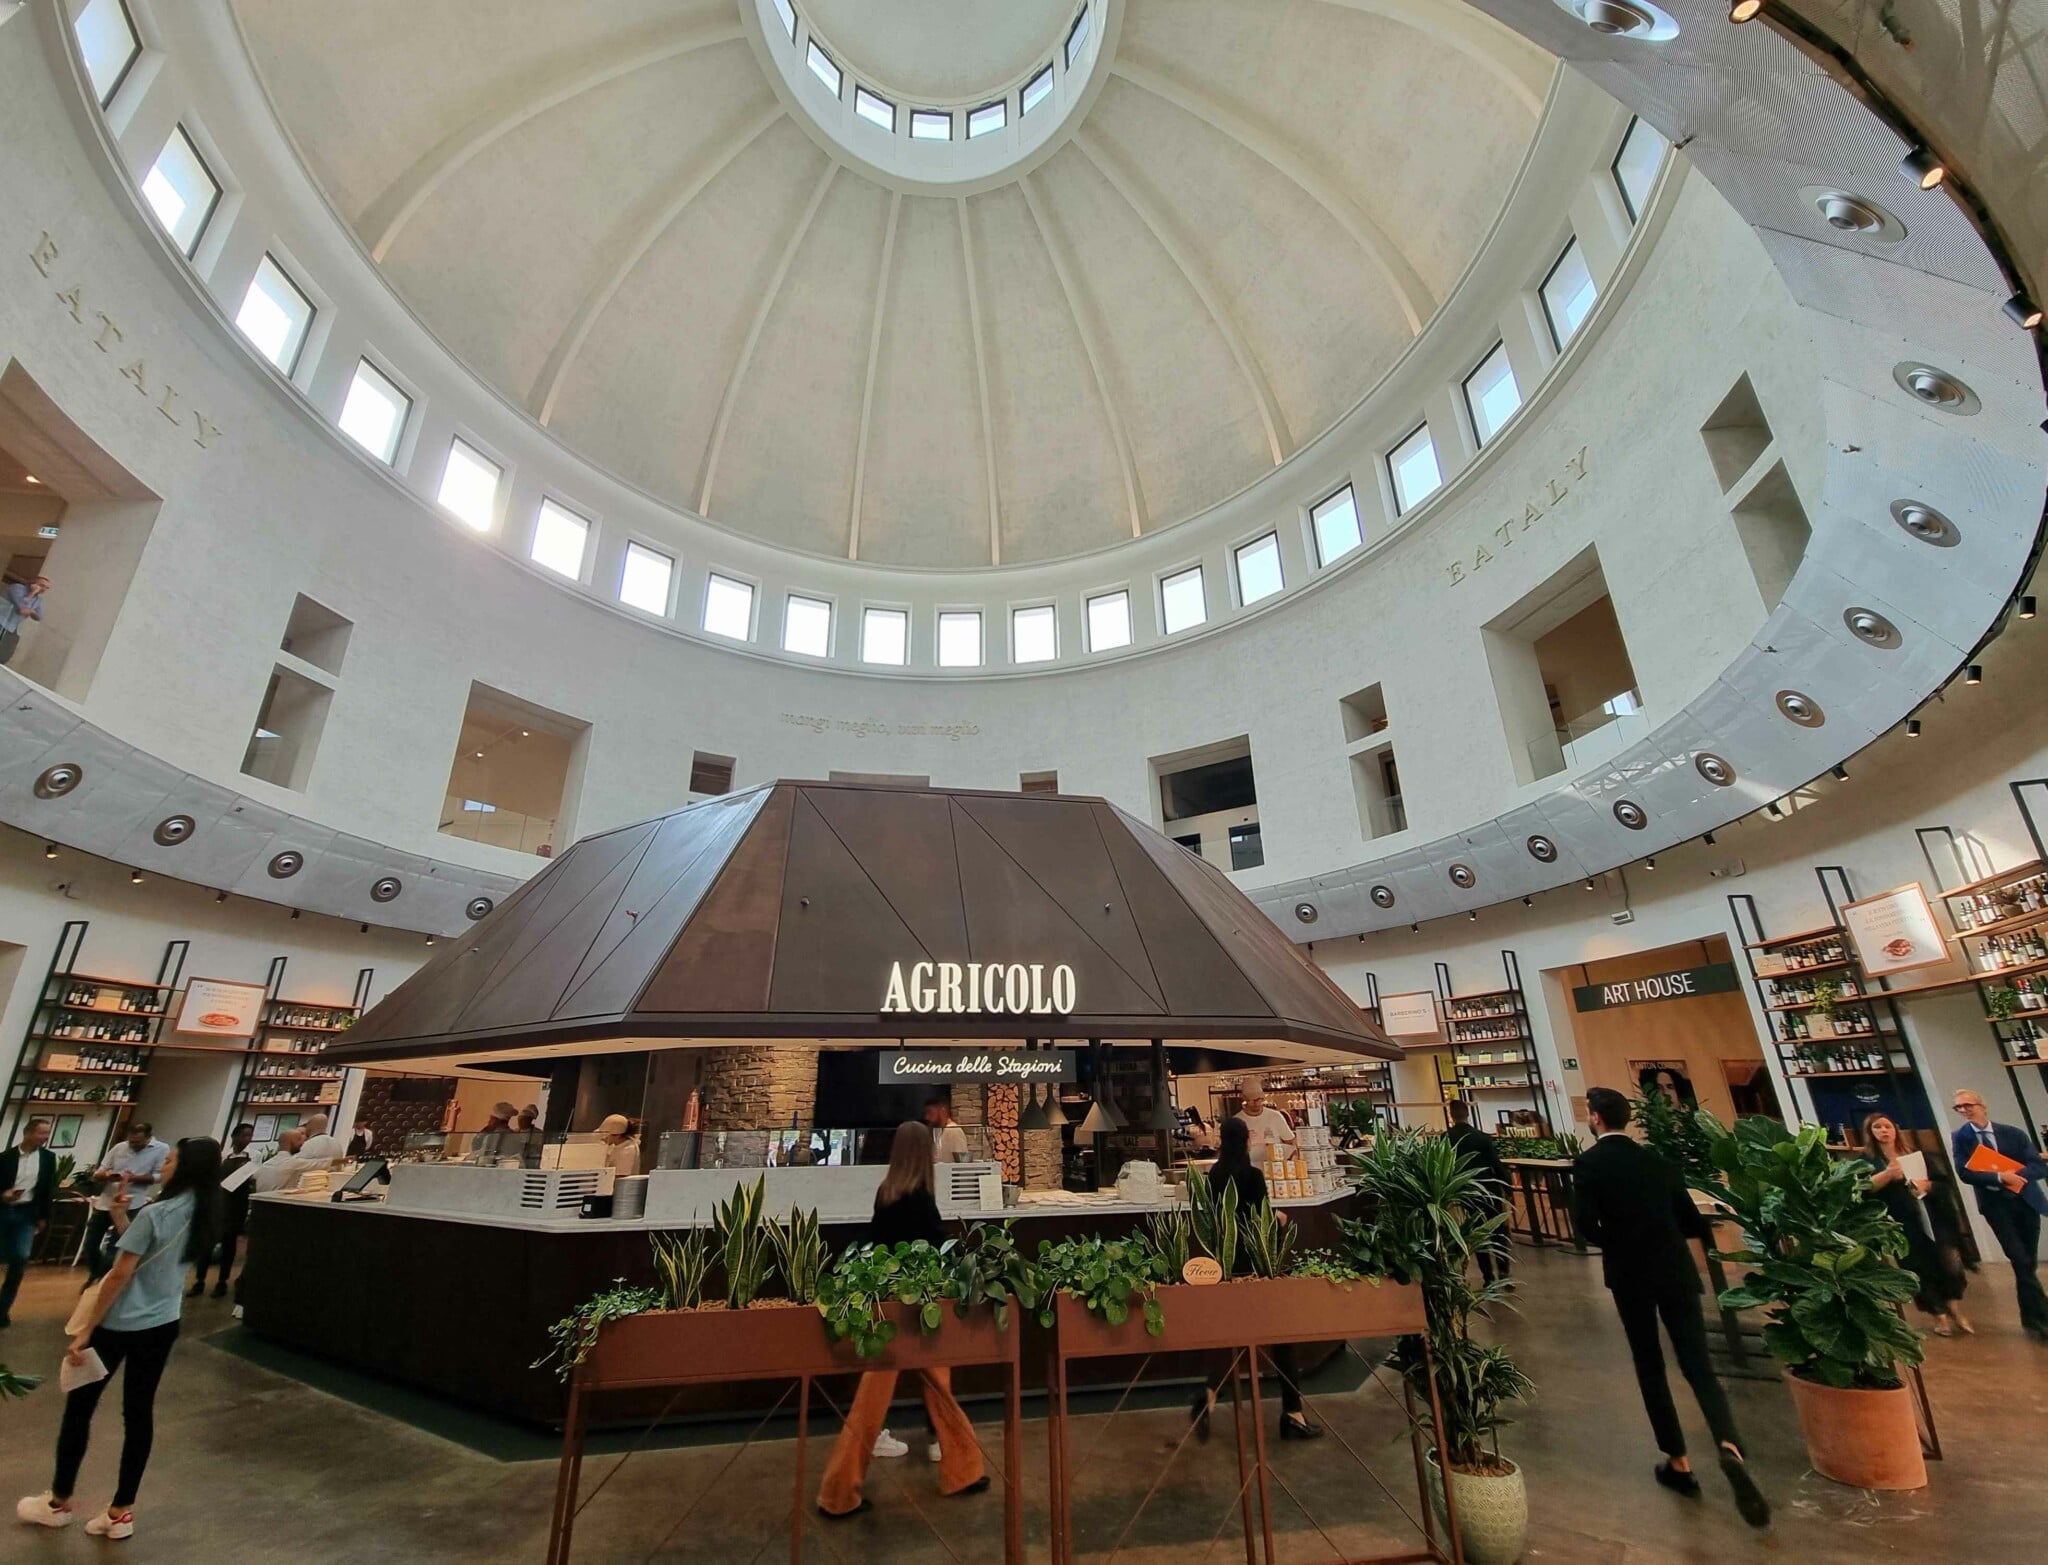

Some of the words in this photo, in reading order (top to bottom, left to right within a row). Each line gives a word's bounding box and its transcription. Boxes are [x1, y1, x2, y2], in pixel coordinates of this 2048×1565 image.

[28, 230, 224, 450] EATALY
[1445, 445, 1588, 588] EATALY
[879, 960, 1077, 1015] AGRICOLO
[1603, 982, 1631, 1005] ART
[1633, 972, 1697, 1001] HOUSE
[893, 1056, 953, 1075] Cucina
[955, 1055, 993, 1075] delle
[996, 1055, 1063, 1079] Stagioni
